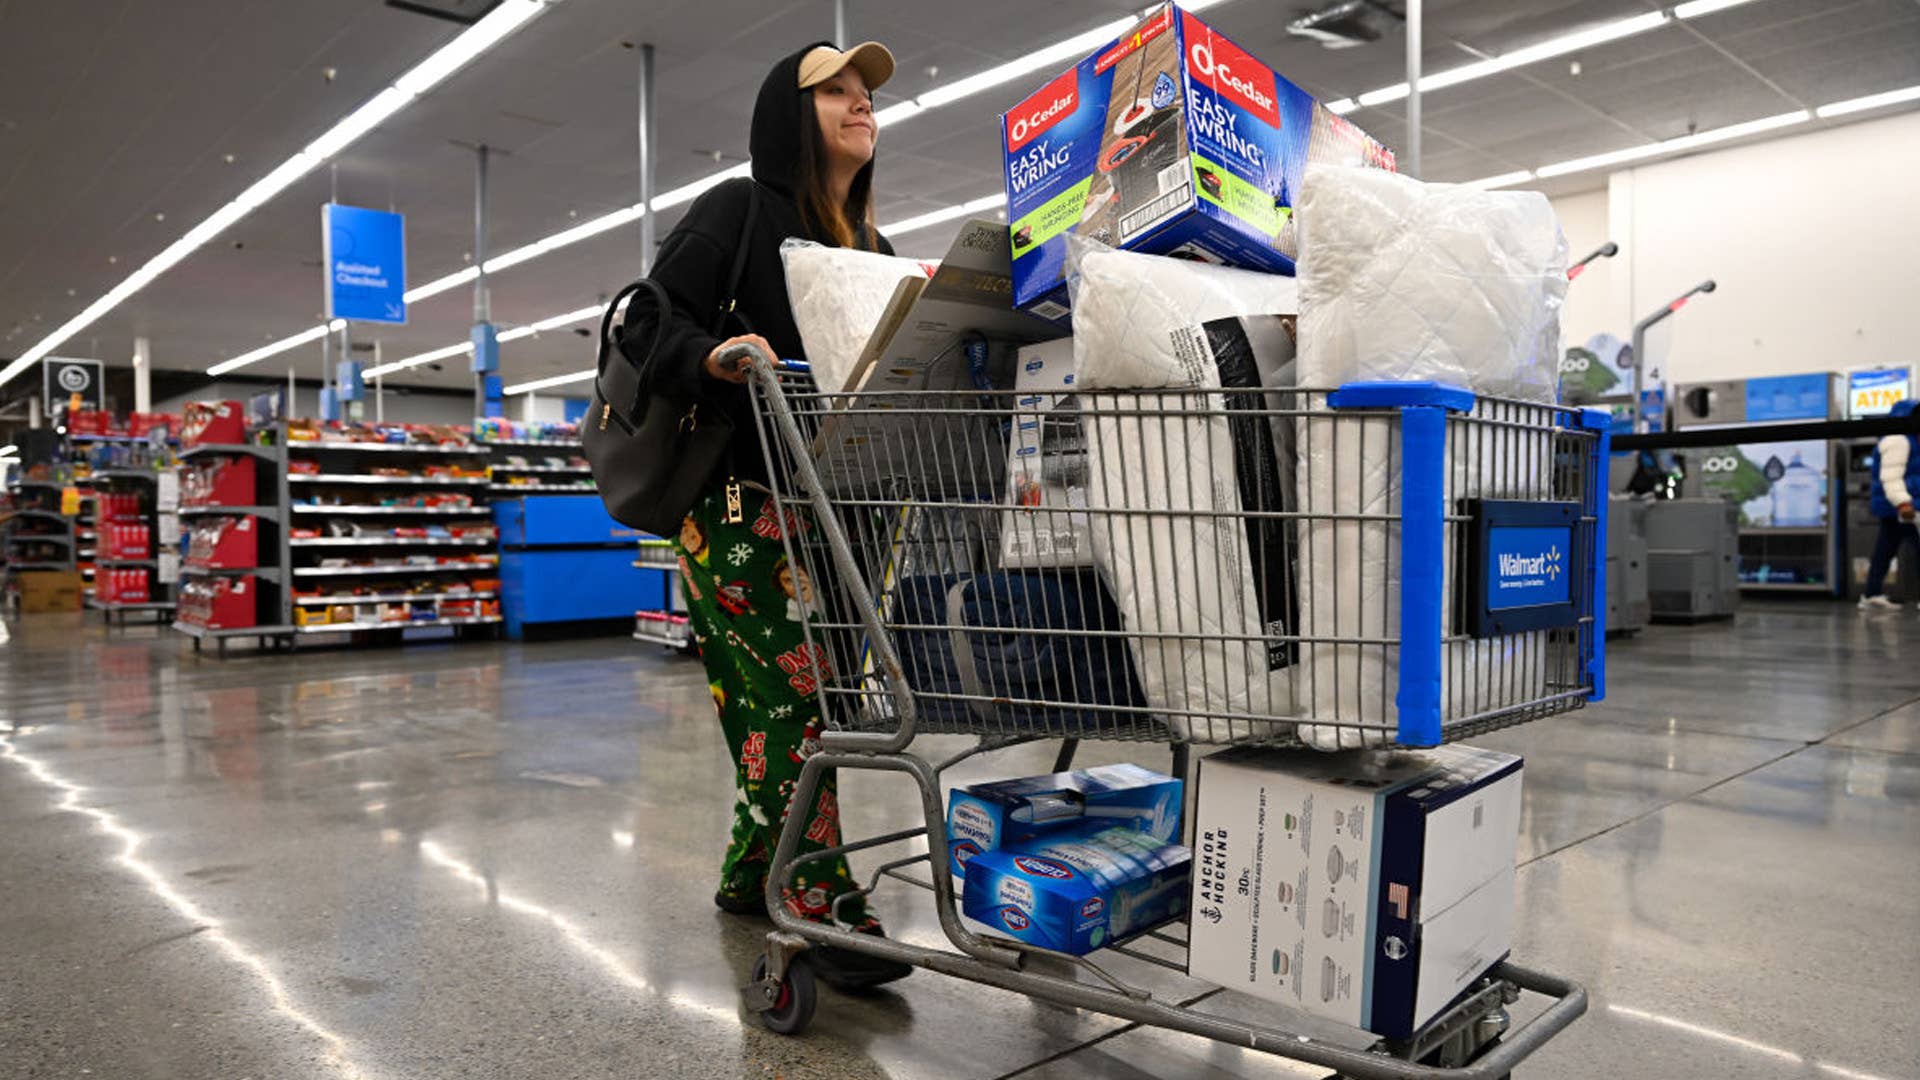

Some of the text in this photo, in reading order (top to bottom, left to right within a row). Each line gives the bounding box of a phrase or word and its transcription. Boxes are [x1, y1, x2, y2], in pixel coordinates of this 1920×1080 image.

[1192, 43, 1273, 111] O-Cedar
[1012, 92, 1074, 141] O-Cedar
[1191, 89, 1237, 132] EASY
[1010, 140, 1048, 178] EASY
[336, 261, 382, 276] Assisted
[336, 272, 388, 288] Checkout
[1856, 389, 1903, 408] ATM
[1499, 553, 1545, 576] Walmart
[1201, 831, 1215, 901] ANCHOR
[1213, 829, 1228, 904] HOCKING
